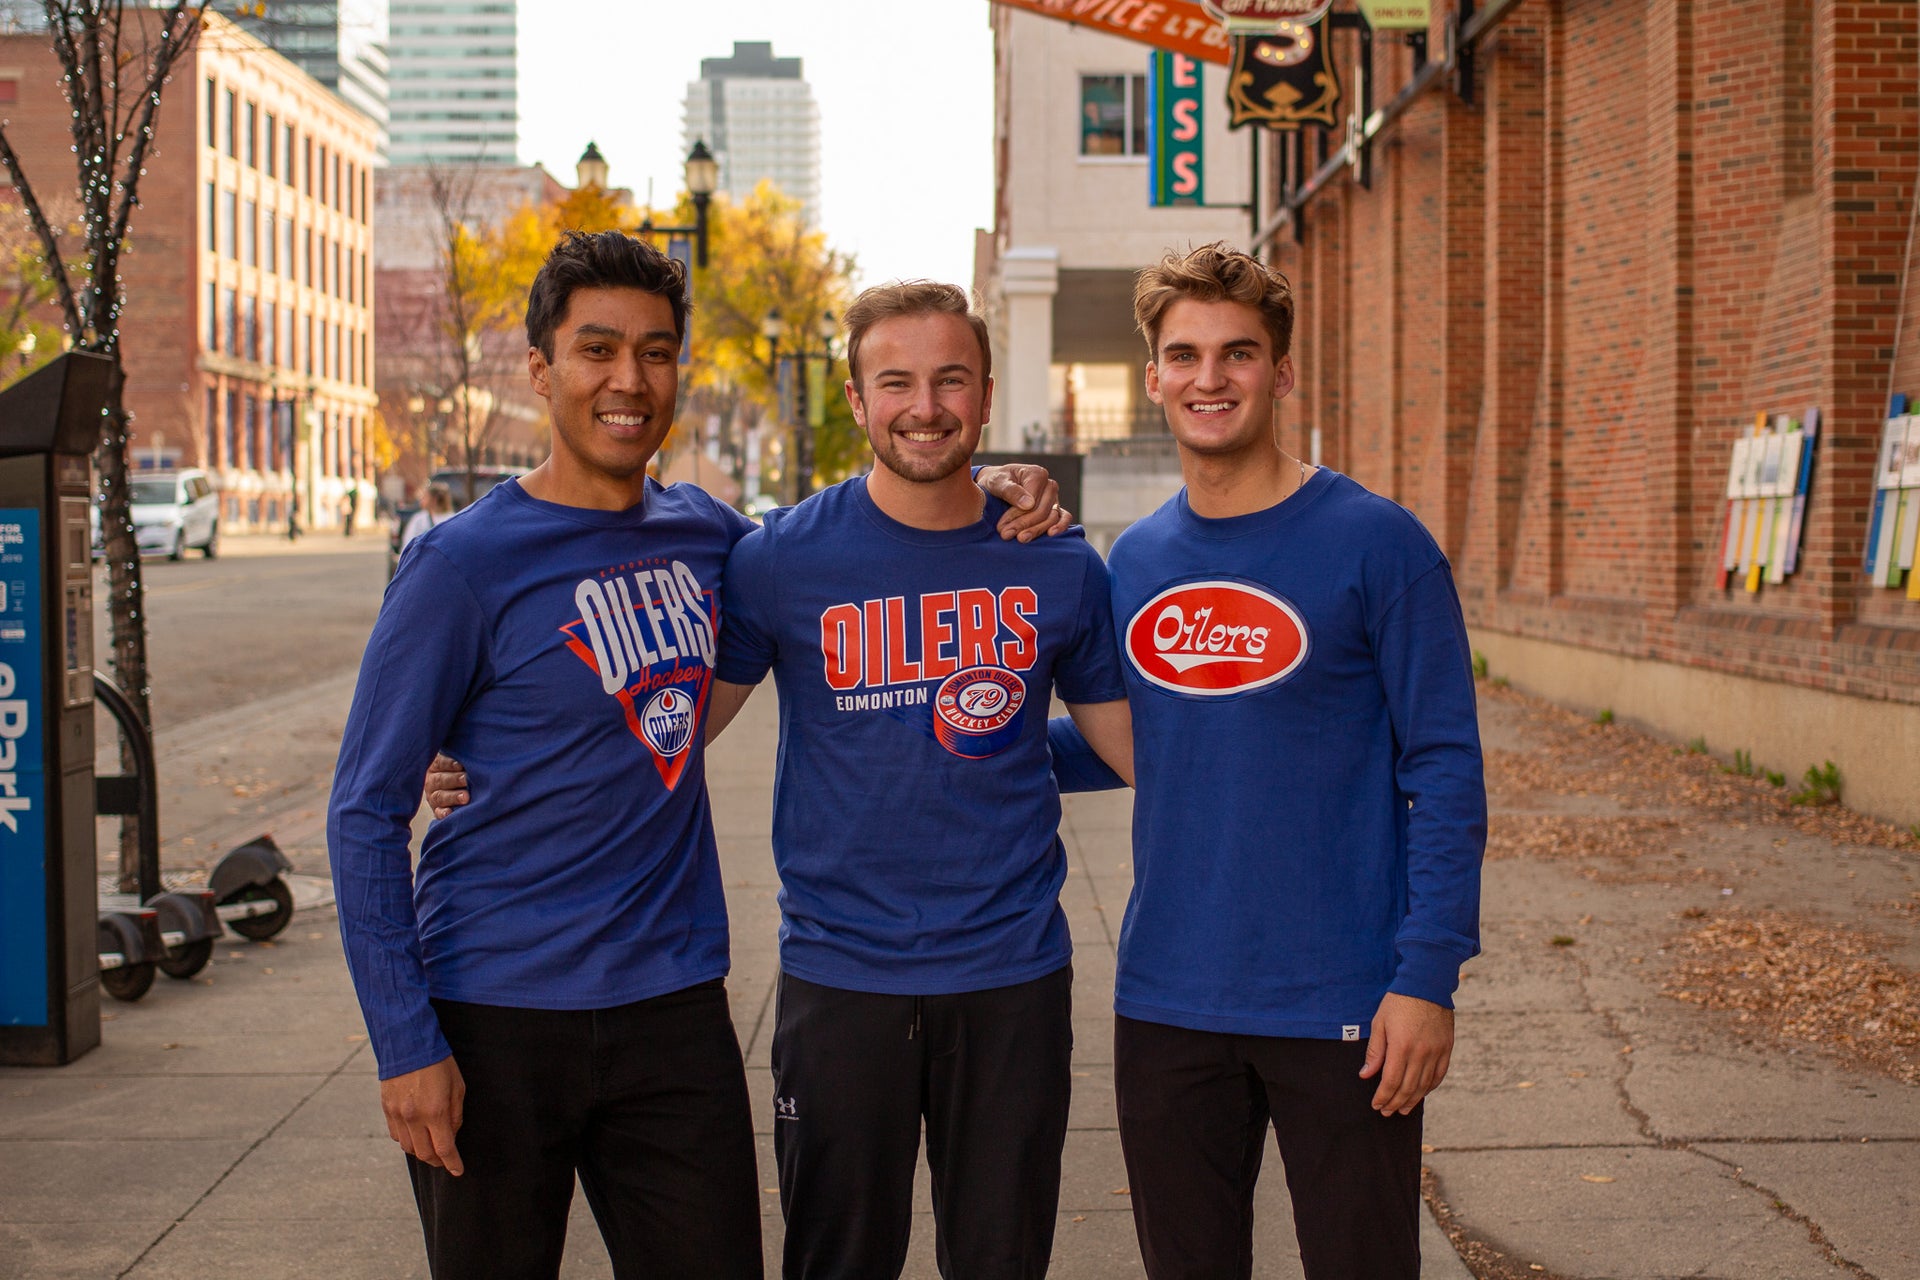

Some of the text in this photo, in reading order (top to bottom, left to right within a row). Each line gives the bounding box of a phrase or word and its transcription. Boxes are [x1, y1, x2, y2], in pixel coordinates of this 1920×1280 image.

[575, 560, 716, 695] OILERS
[820, 586, 1038, 690] OILERS
[1153, 605, 1270, 655] Oilers
[629, 656, 703, 697] Hockey
[945, 670, 1020, 694] EDMONTON OILERS
[836, 687, 928, 711] EDMONTON
[945, 702, 1018, 728] HOCKEY CLUB
[965, 688, 1004, 710] 79
[648, 711, 689, 751] OILERS
